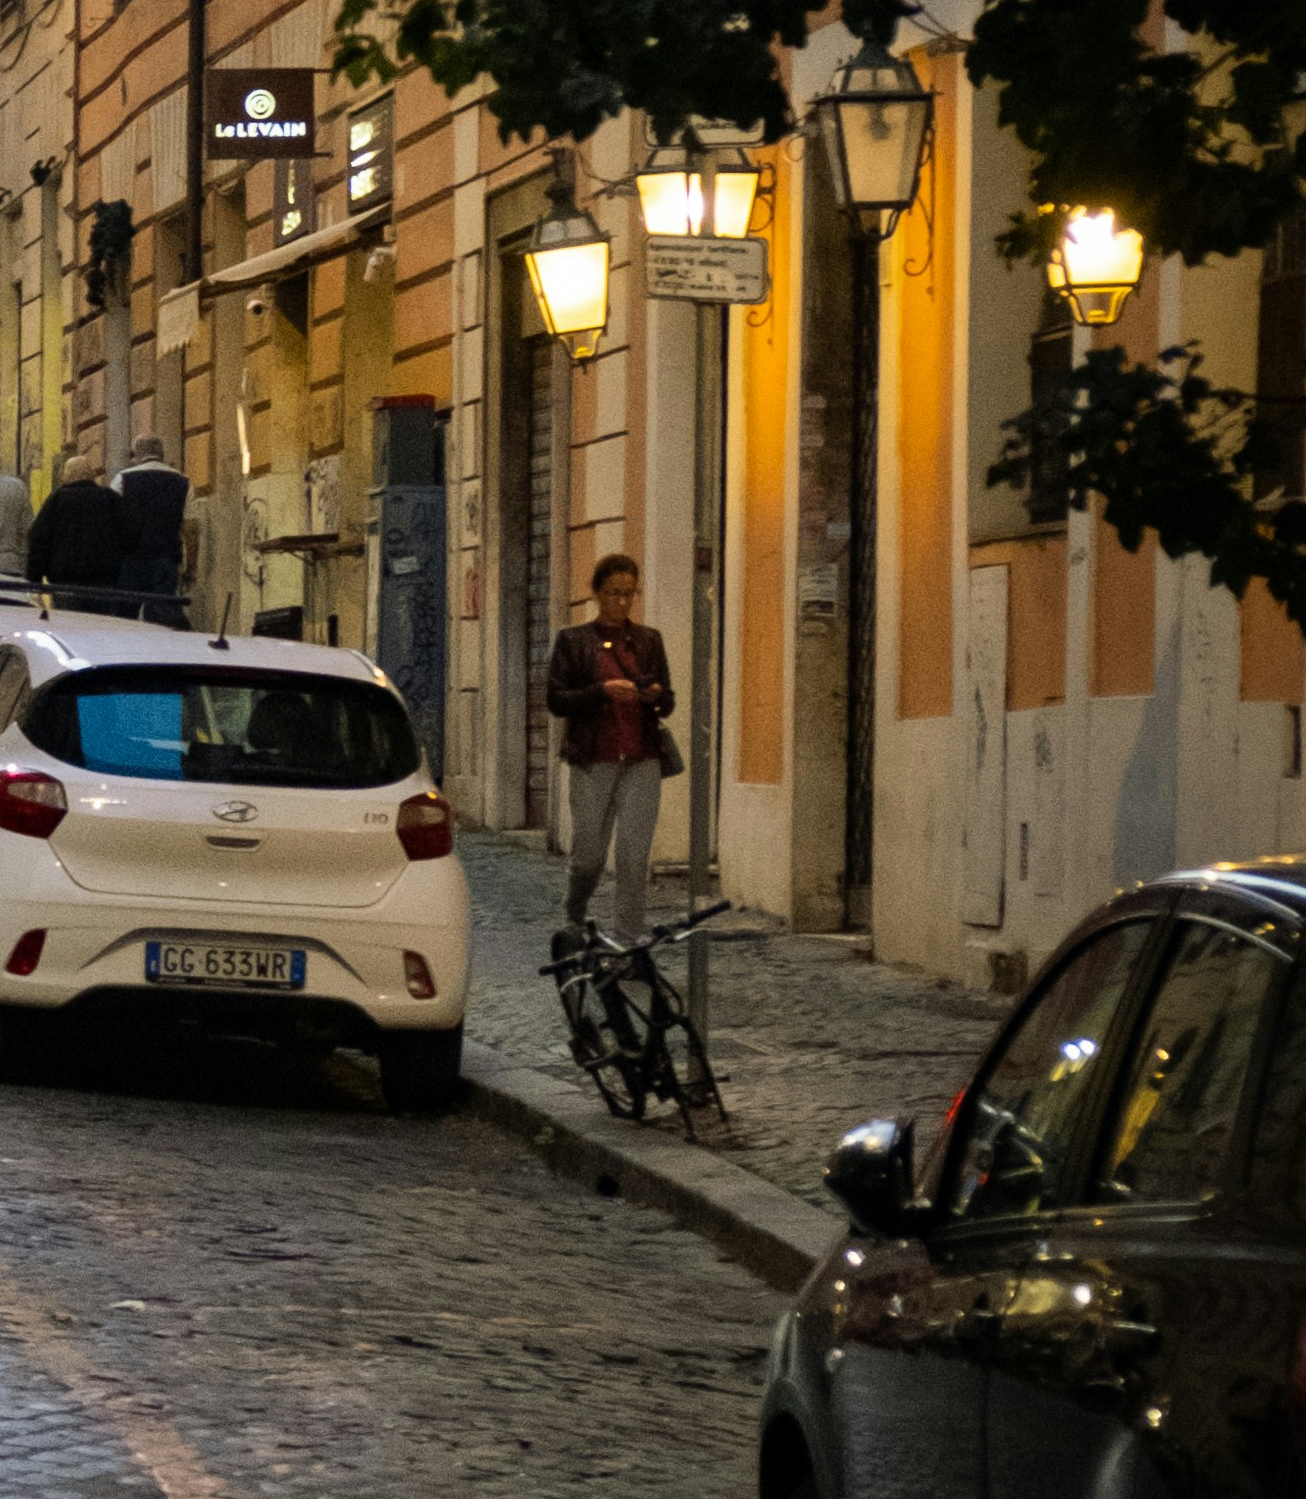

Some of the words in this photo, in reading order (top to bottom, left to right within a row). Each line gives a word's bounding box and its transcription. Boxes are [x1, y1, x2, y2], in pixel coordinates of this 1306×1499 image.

[236, 122, 307, 138] LEVAIN
[163, 947, 195, 973] GG
[205, 949, 287, 979] 633WR
